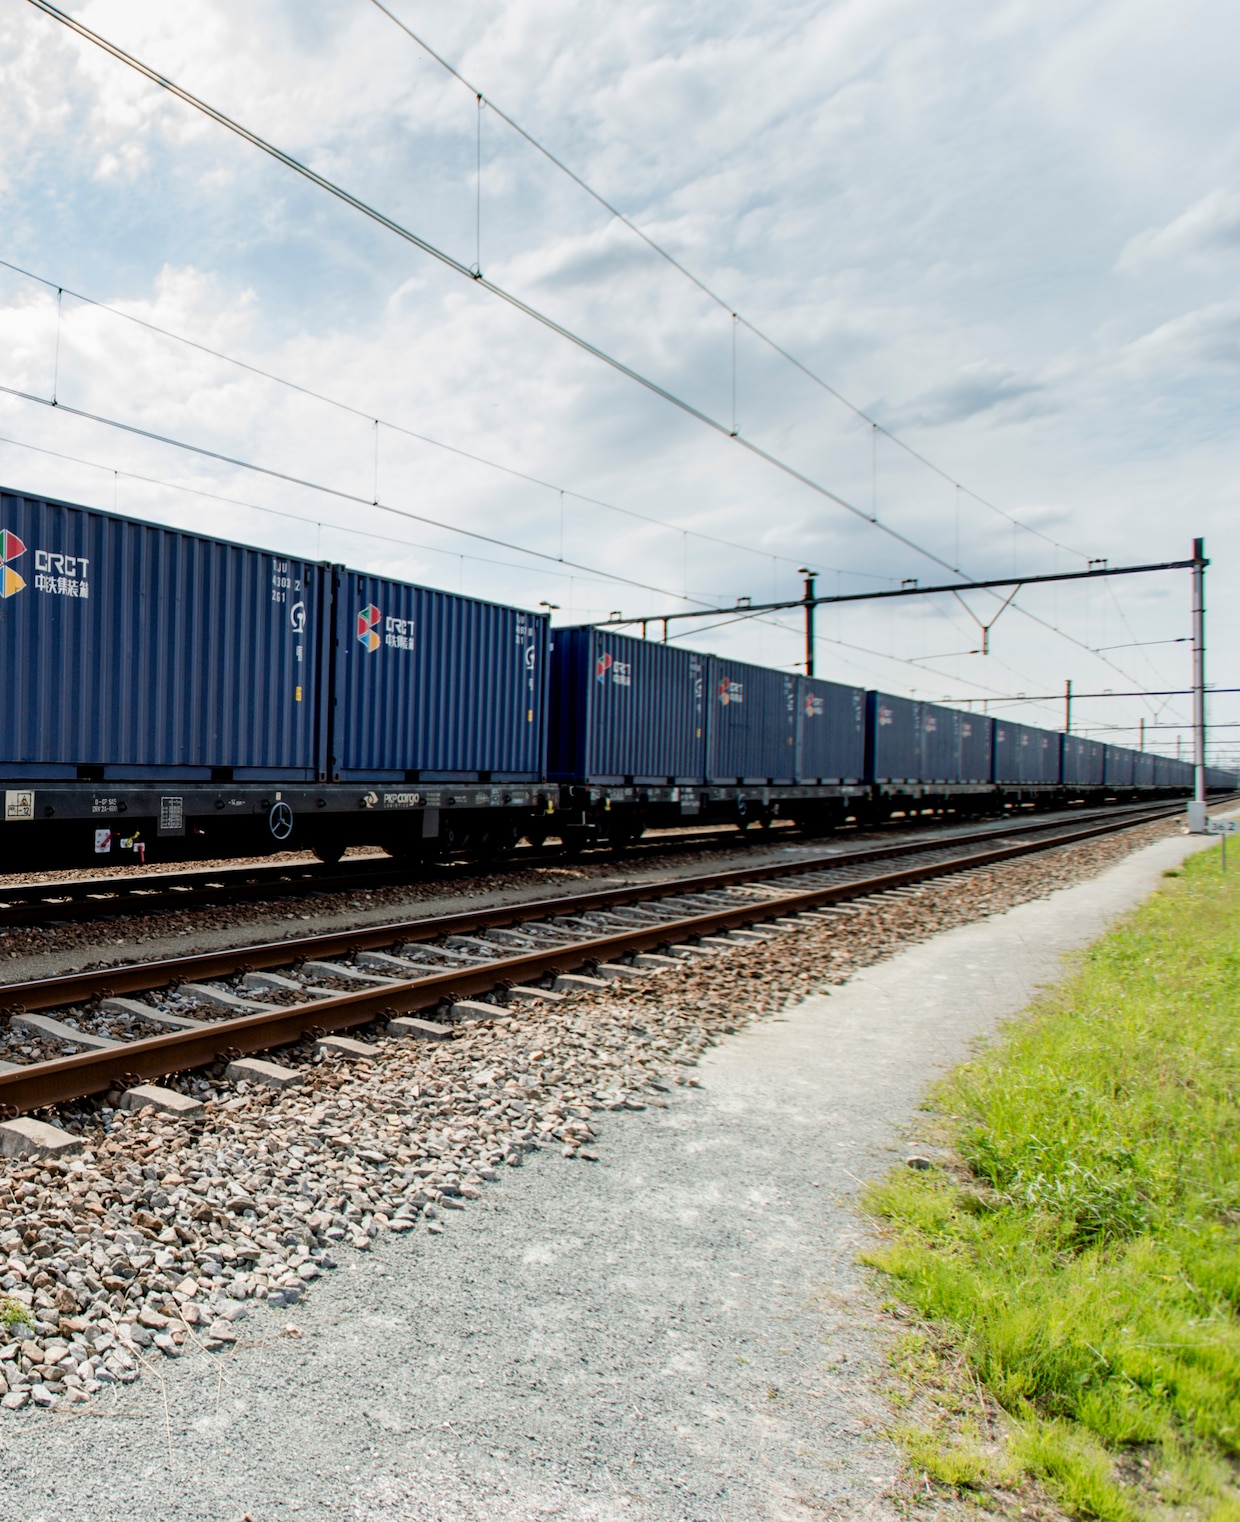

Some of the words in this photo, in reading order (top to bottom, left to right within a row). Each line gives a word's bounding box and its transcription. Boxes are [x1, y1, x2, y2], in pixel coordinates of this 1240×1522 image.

[35, 550, 90, 578] CRCT
[35, 573, 89, 599] 中铁集装箱
